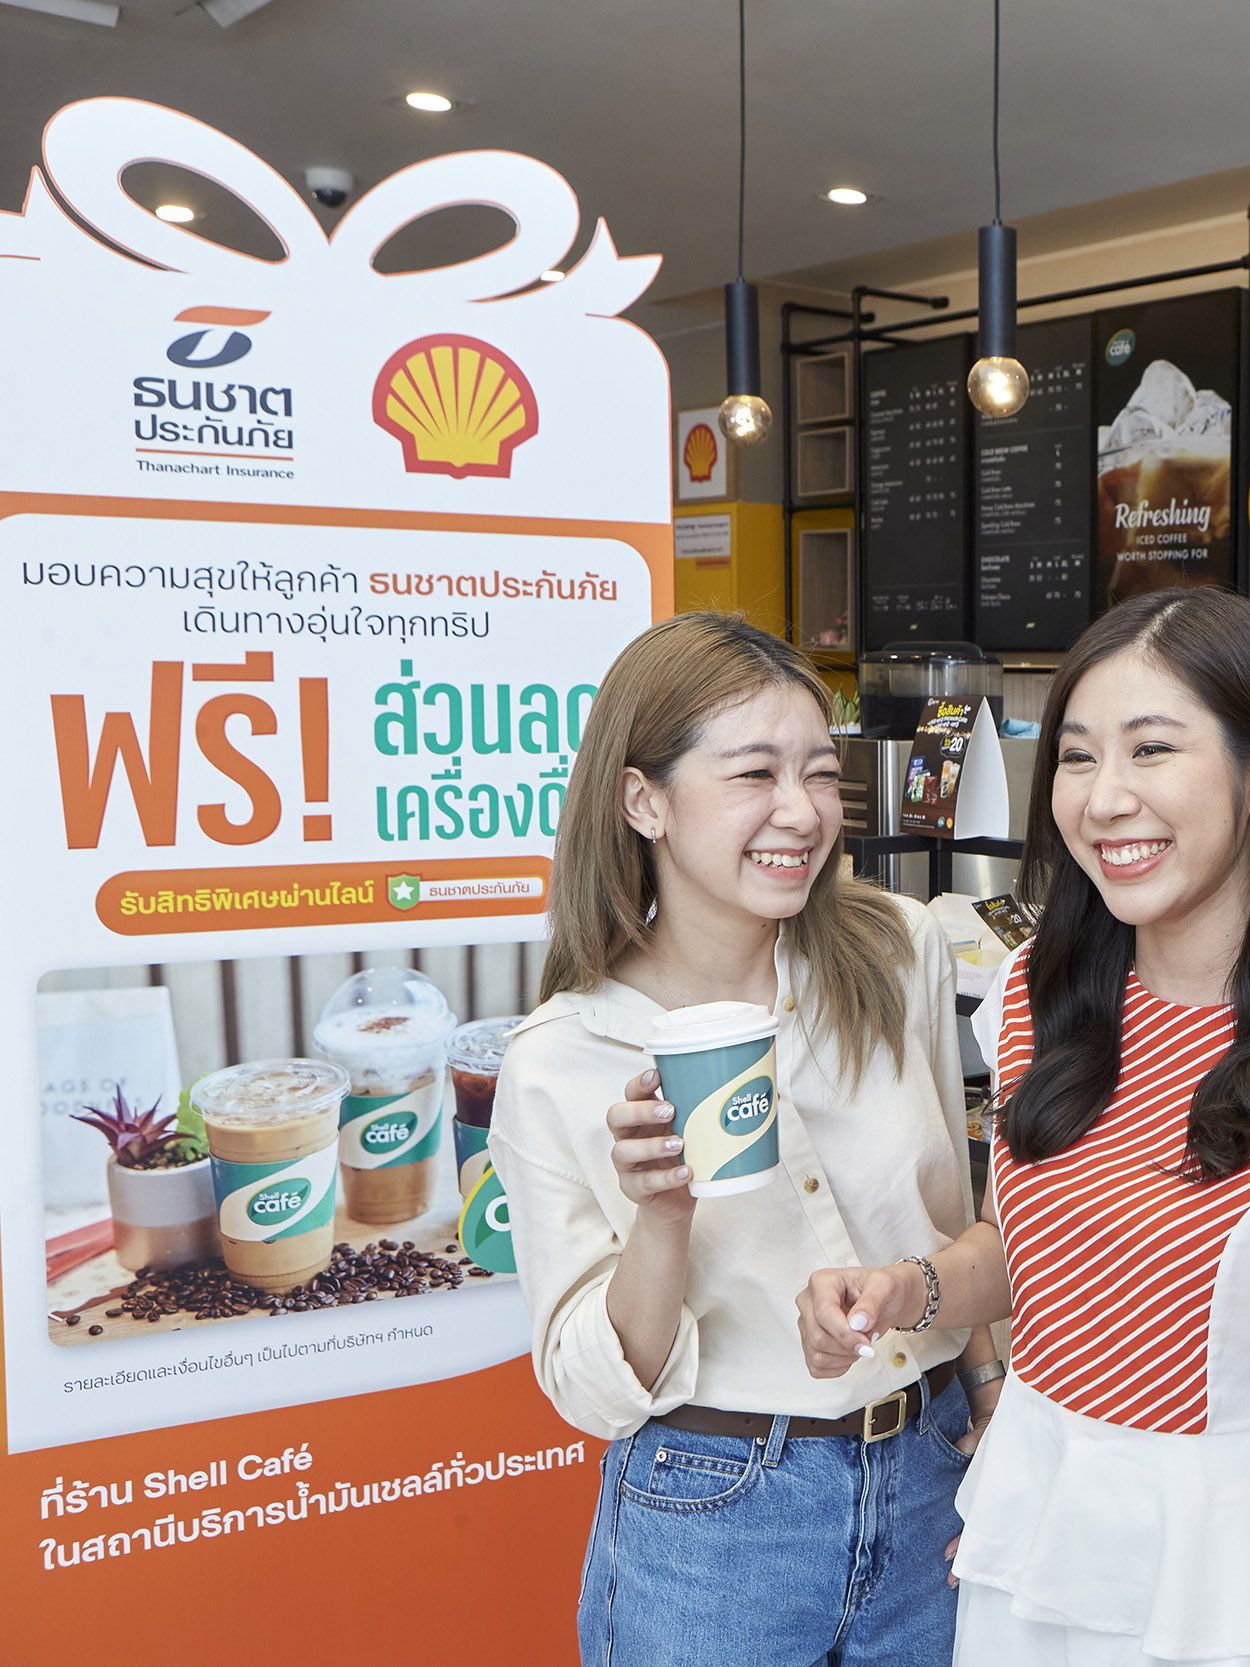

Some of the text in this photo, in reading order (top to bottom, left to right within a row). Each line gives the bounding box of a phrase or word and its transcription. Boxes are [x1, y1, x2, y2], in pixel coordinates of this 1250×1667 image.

[132, 376, 293, 417] ธนชาต
[134, 414, 294, 449] ประกันภัย
[136, 460, 295, 479] Thanachart Insurance
[1114, 497, 1211, 531] Refreshing
[1116, 548, 1208, 562] WORTH STOPPING FOR
[1136, 533, 1188, 546] ICED COFFEE
[22, 558, 618, 602] มอบความสุขให้ลูกค้า ธนชาตประกันภัย
[183, 604, 489, 646] เดินทางอุ่นใจทุกทริป
[50, 651, 333, 850] ฟรี!
[950, 737, 963, 752] 20
[376, 755, 568, 842] เครื่องดื่
[120, 880, 374, 917] รับสิทธิพิเศษผ่านไลน์
[429, 879, 530, 899] ธนชาตประกันภัย
[726, 1092, 769, 1121] café
[732, 1093, 752, 1105] Shell
[253, 1192, 301, 1213] café
[63, 1323, 434, 1393] รายละเอียดและเงื่อนไขอื่นๆ เป็นไปตามที่บริษัทฯ กำหนด
[40, 1443, 313, 1519] ที่ร้าน Shell Café
[38, 1440, 585, 1571] ในสถานีบริการน้ำมันเชลล์ทั่วประเทศ
